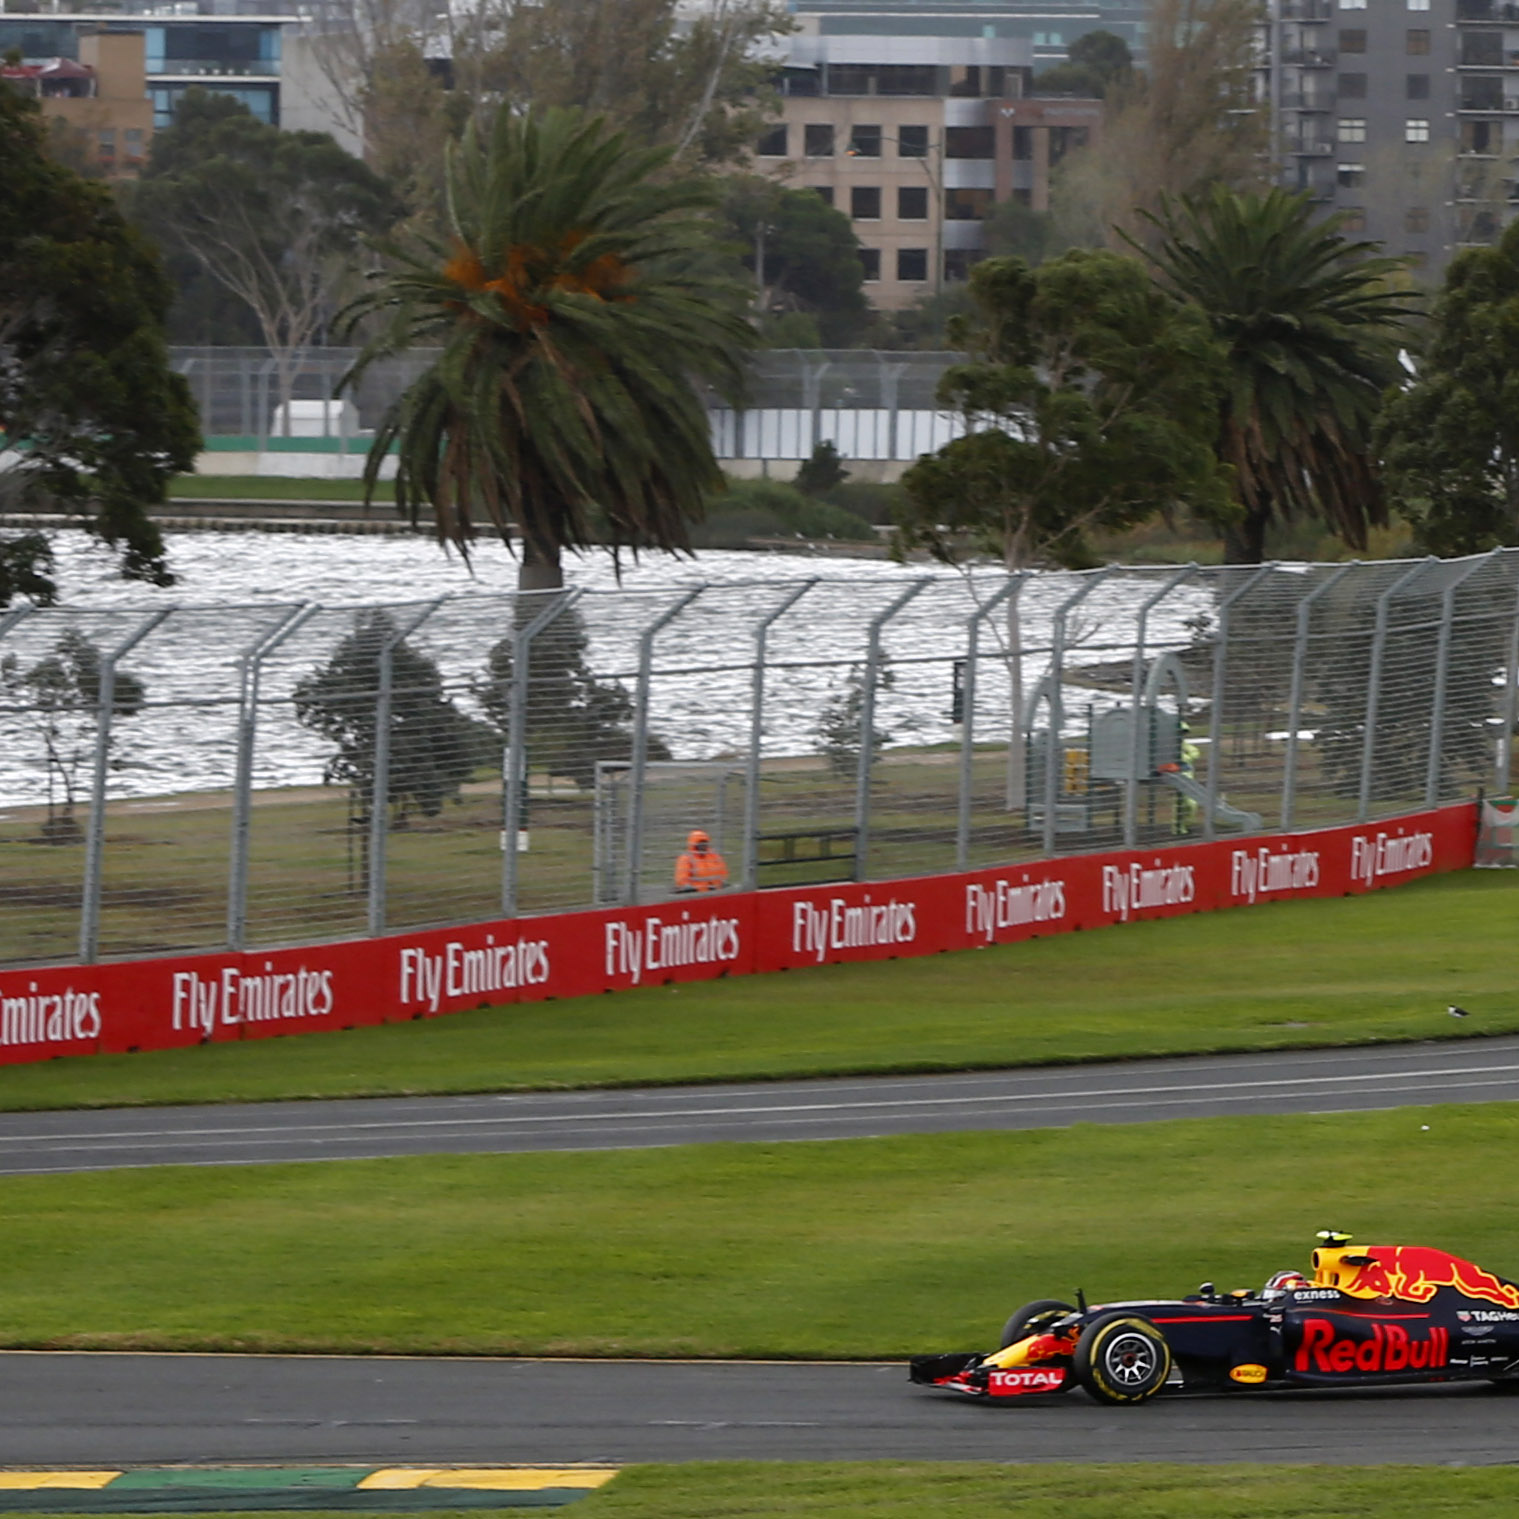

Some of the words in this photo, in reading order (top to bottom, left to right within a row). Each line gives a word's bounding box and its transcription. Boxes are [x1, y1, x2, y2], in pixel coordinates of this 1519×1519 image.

[1102, 865, 1129, 921] Fly
[1130, 858, 1195, 909] Emirates
[1232, 850, 1258, 904] Fly
[1258, 843, 1320, 892] Emirates
[1352, 836, 1376, 887] Fly
[793, 901, 829, 962] Fly
[830, 894, 916, 949] Emirates
[966, 884, 995, 941] Fly
[996, 874, 1066, 928] Emirates
[400, 946, 442, 1012] Fly
[446, 934, 549, 997] Emirates
[605, 921, 642, 984] Fly
[645, 911, 739, 969] Emirates
[0, 981, 101, 1045] mirates
[172, 971, 217, 1039] Fly
[221, 961, 333, 1025] Emirates
[1293, 1290, 1340, 1300] exness
[989, 1372, 1063, 1386] TOTAL
